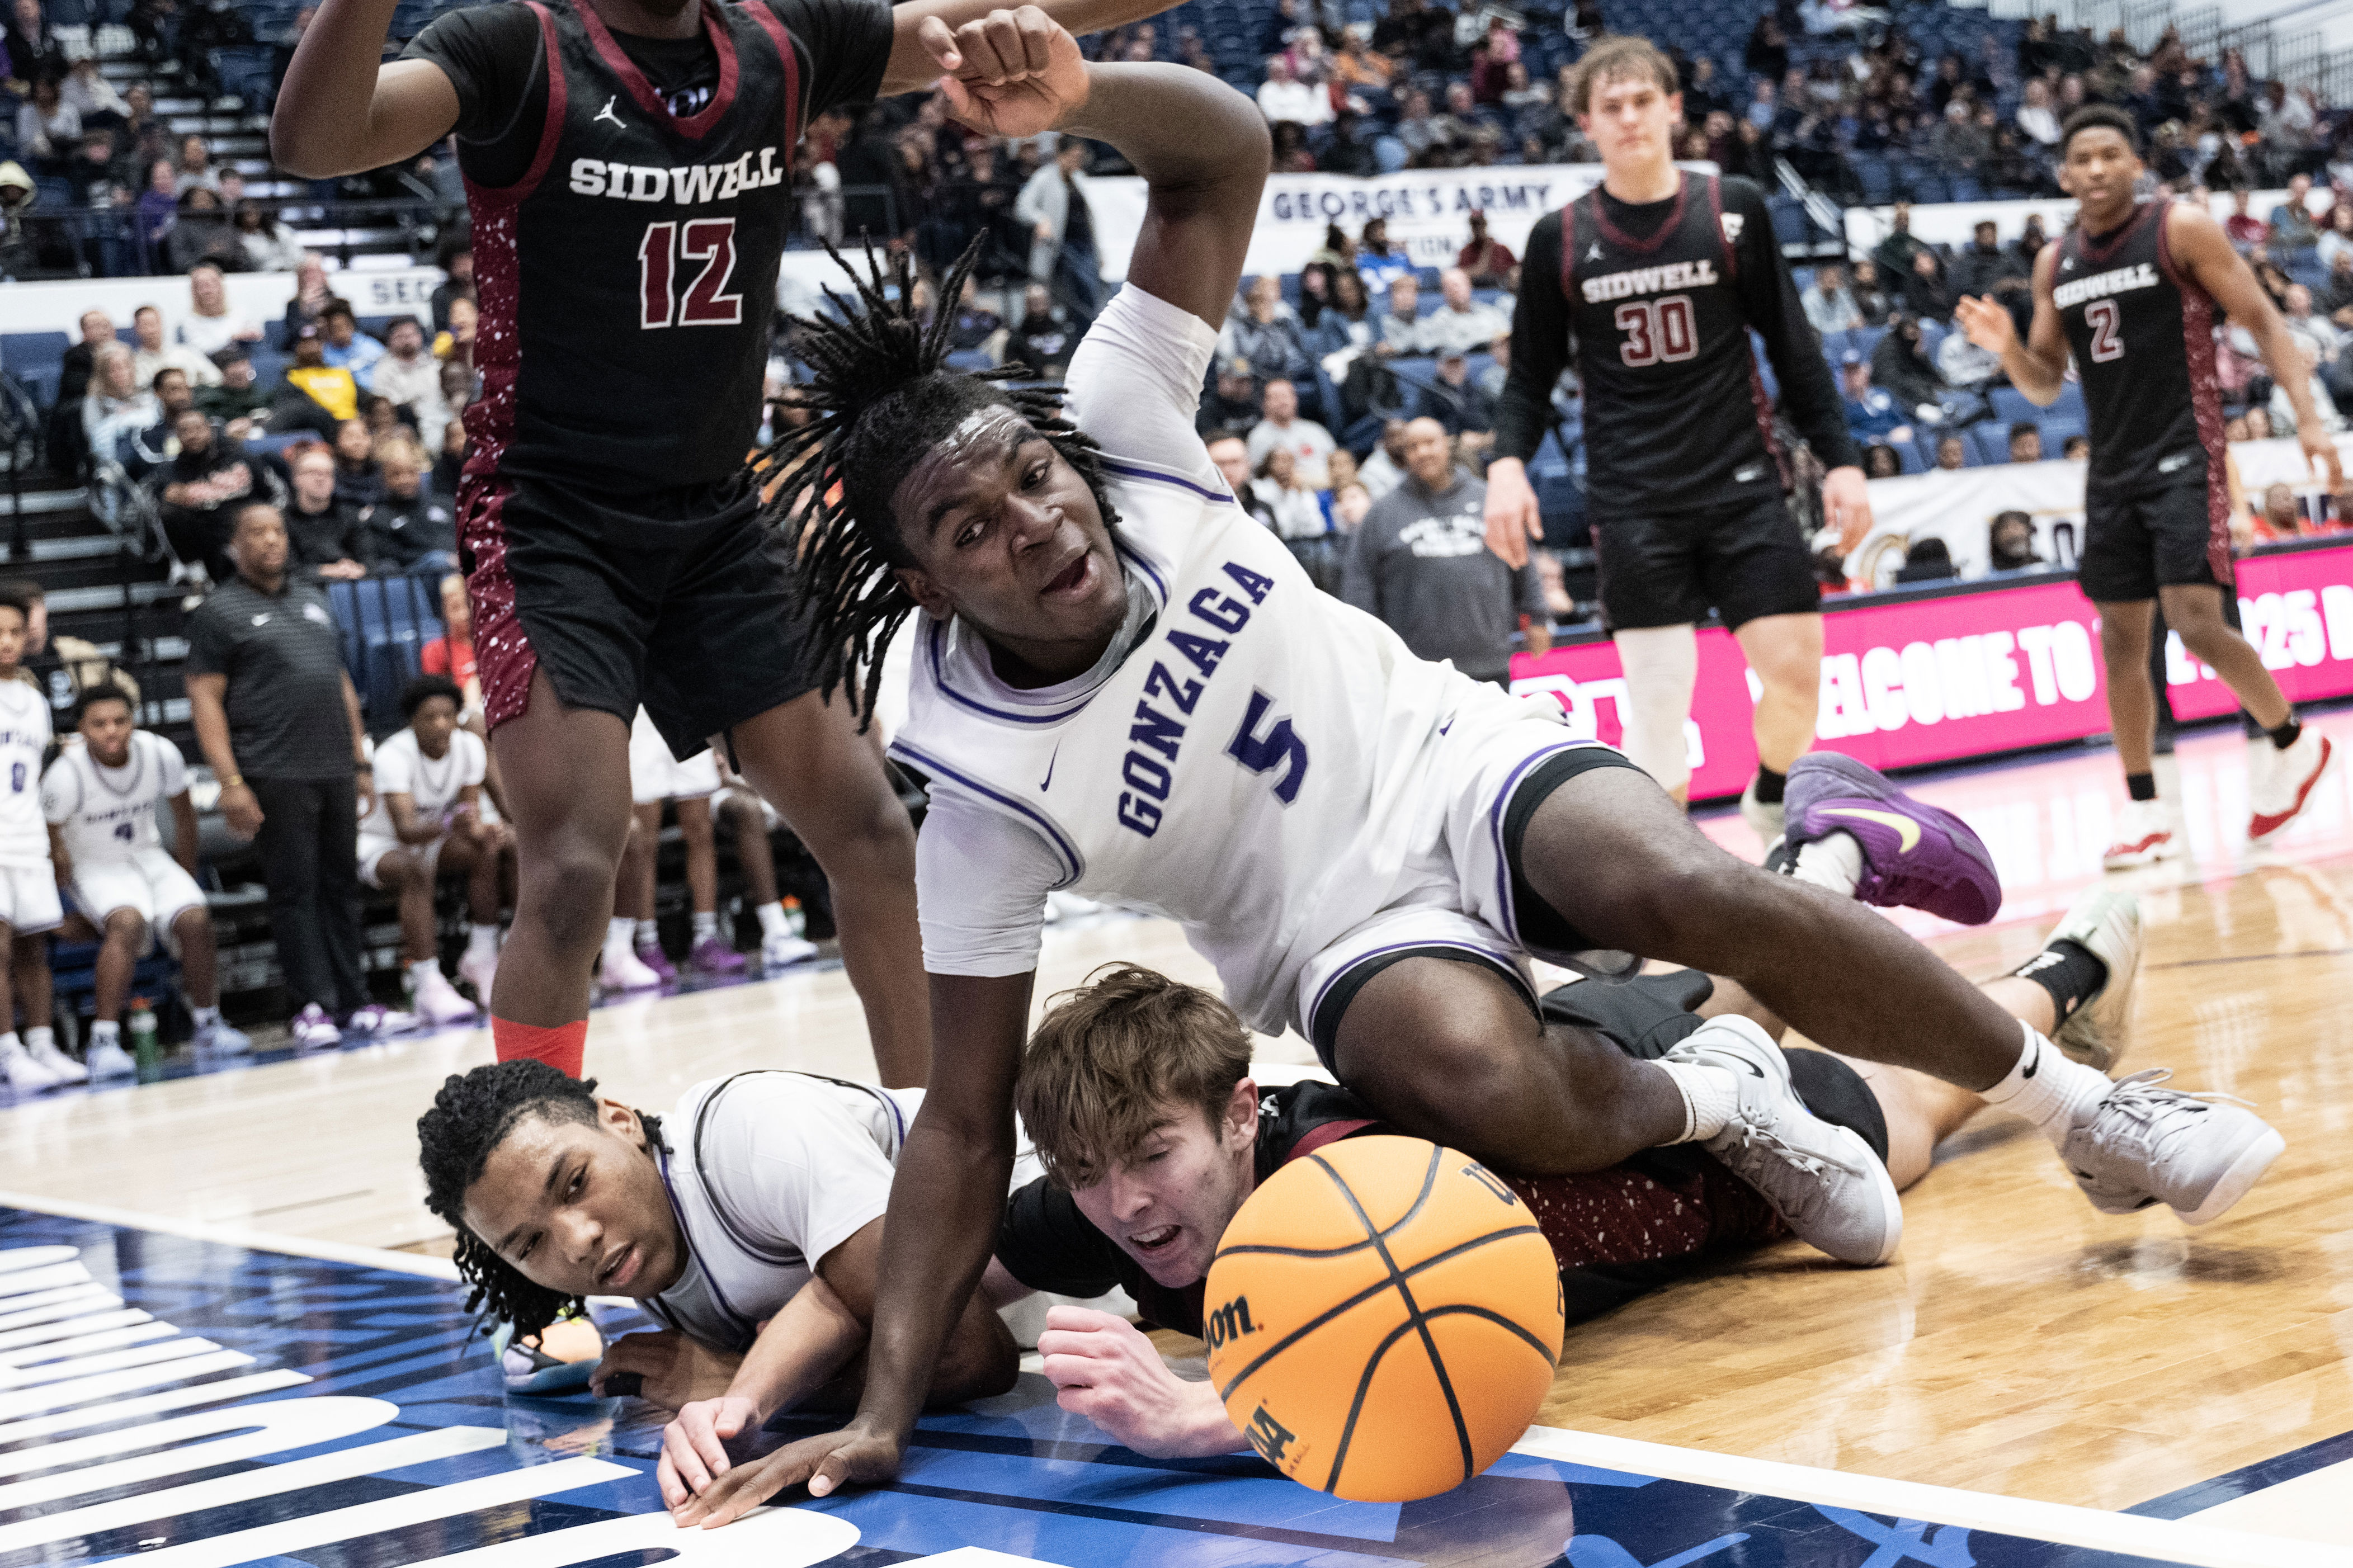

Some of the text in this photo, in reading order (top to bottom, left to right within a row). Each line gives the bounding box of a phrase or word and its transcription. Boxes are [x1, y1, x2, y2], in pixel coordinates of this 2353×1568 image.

[569, 147, 784, 205] SIDWELL
[1454, 185, 1552, 210] ARMY
[638, 217, 743, 330] 12
[1581, 259, 1719, 304] SIDWELL
[1614, 294, 1699, 367] 30
[2084, 299, 2125, 363] 2
[1118, 560, 1276, 839] GONZAGA
[2016, 620, 2096, 706] TO
[1222, 684, 1311, 810] 5
